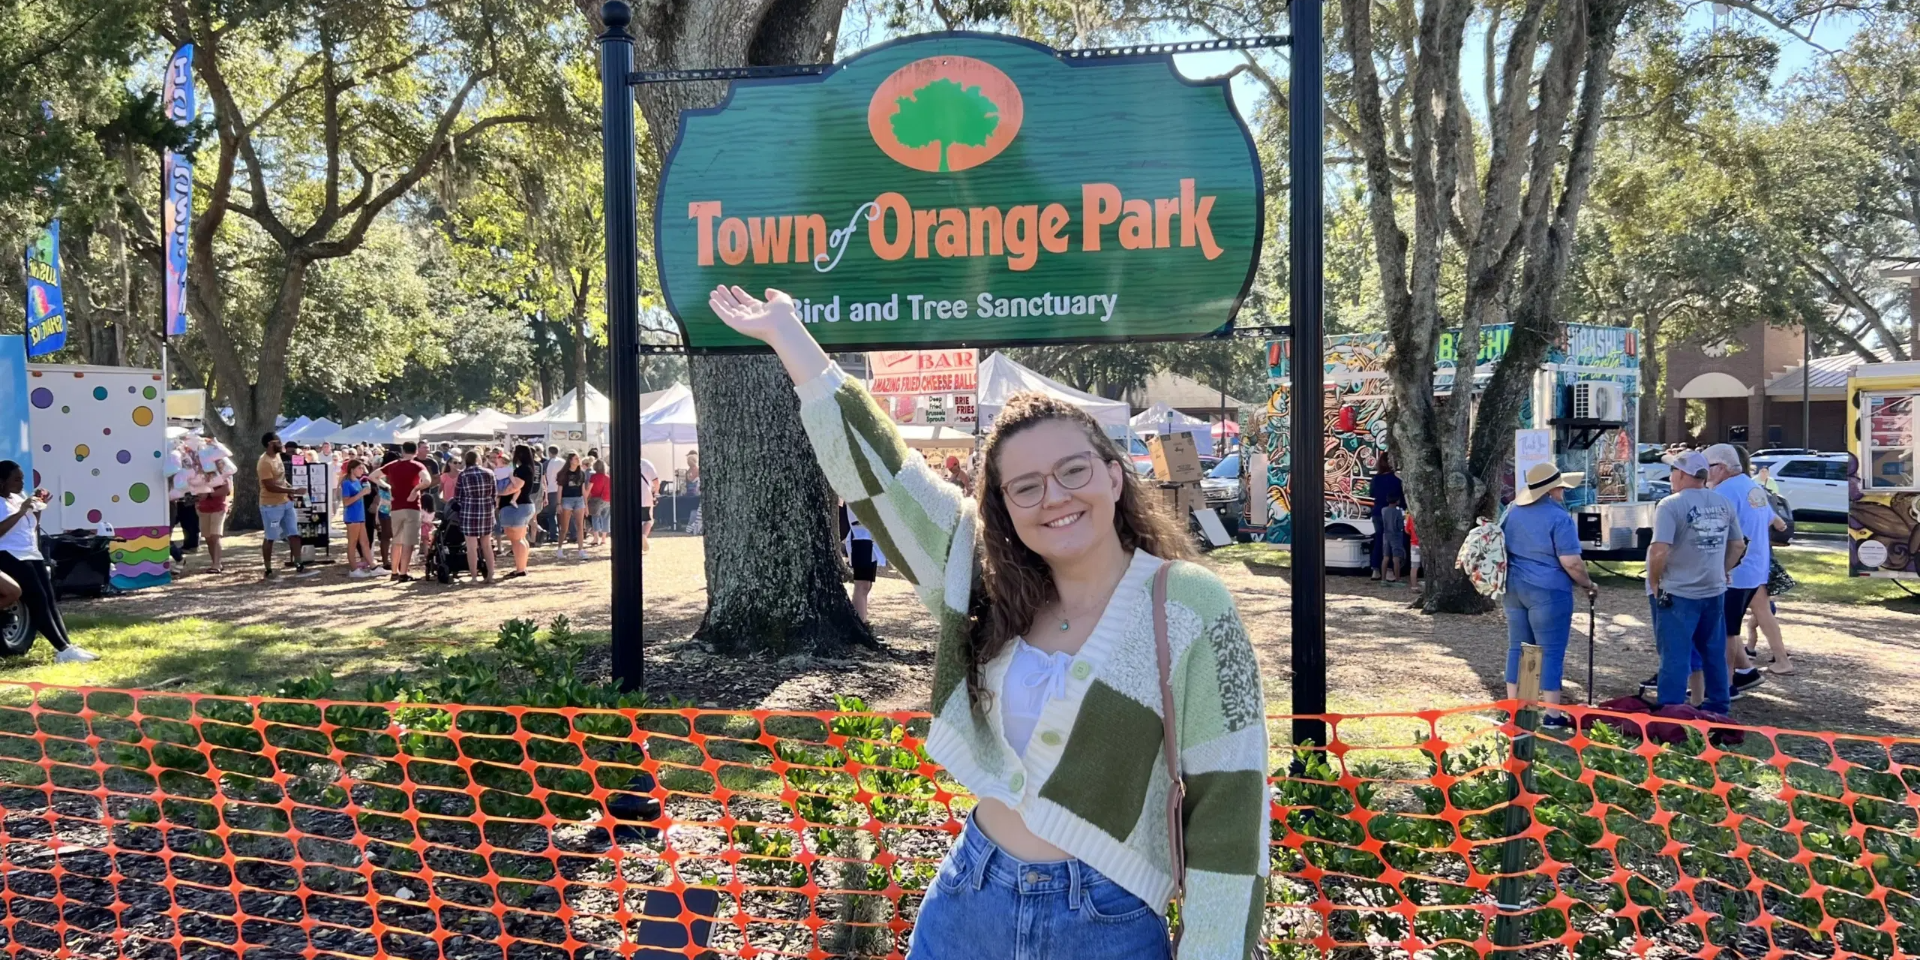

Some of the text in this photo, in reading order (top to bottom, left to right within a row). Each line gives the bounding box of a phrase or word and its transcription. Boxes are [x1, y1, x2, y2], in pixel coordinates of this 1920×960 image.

[688, 178, 1225, 273] Town of Orange Park
[849, 293, 899, 322] and
[907, 294, 969, 321] Tree
[976, 291, 1118, 322] Sanctuary
[917, 351, 974, 370] BAR
[871, 377, 901, 393] AMAZING
[901, 376, 921, 392] FRIED
[921, 374, 953, 391] CHEESE
[954, 396, 970, 405] BRIE
[956, 405, 975, 415] FRIES
